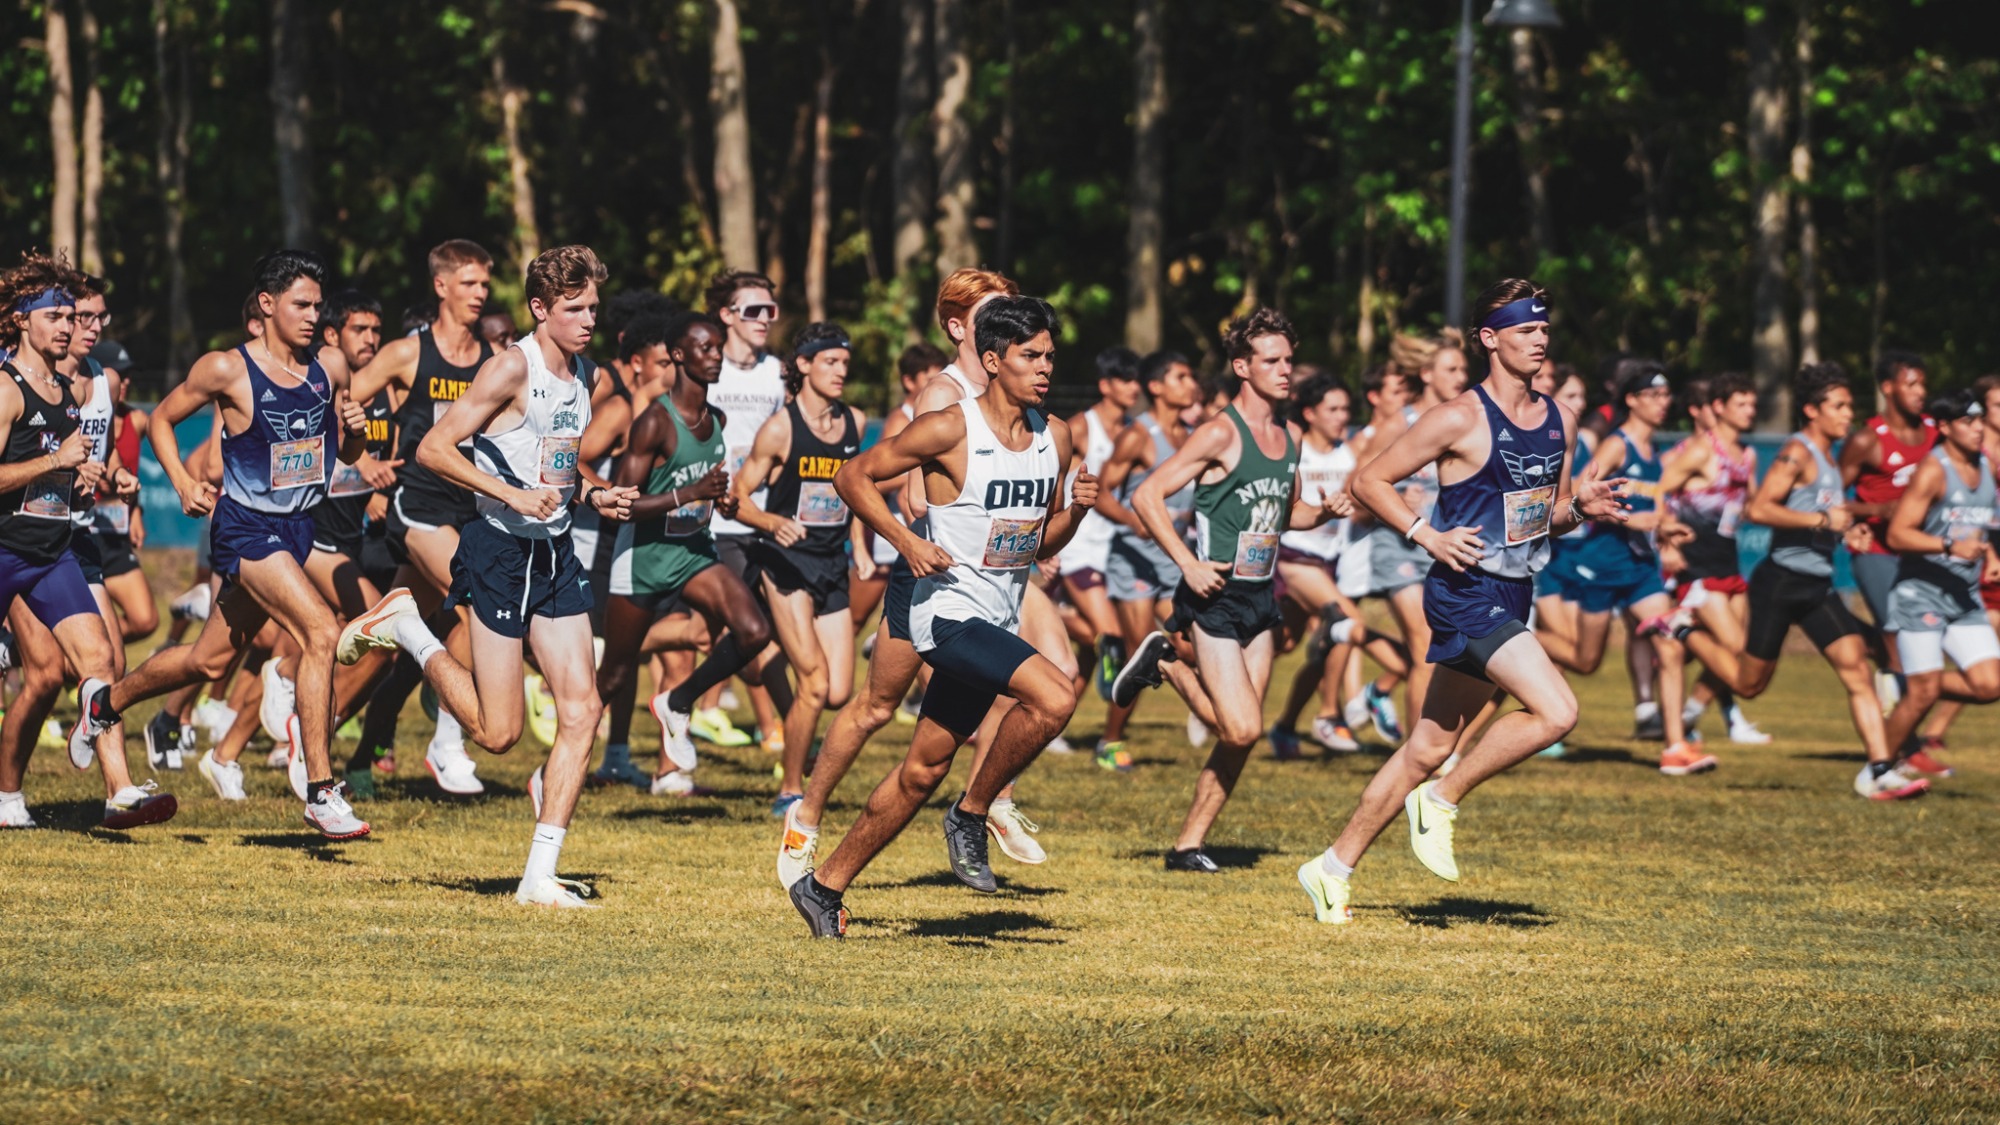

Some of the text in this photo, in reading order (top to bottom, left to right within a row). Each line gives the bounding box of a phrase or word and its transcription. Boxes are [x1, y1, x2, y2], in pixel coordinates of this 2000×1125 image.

[429, 377, 472, 400] CAME
[553, 411, 579, 431] SFCC
[282, 452, 313, 472] 770
[799, 456, 848, 478] CAMER
[811, 496, 840, 510] 714
[984, 477, 1055, 511] ORU
[1517, 502, 1545, 525] 772
[994, 532, 1037, 553] 1125
